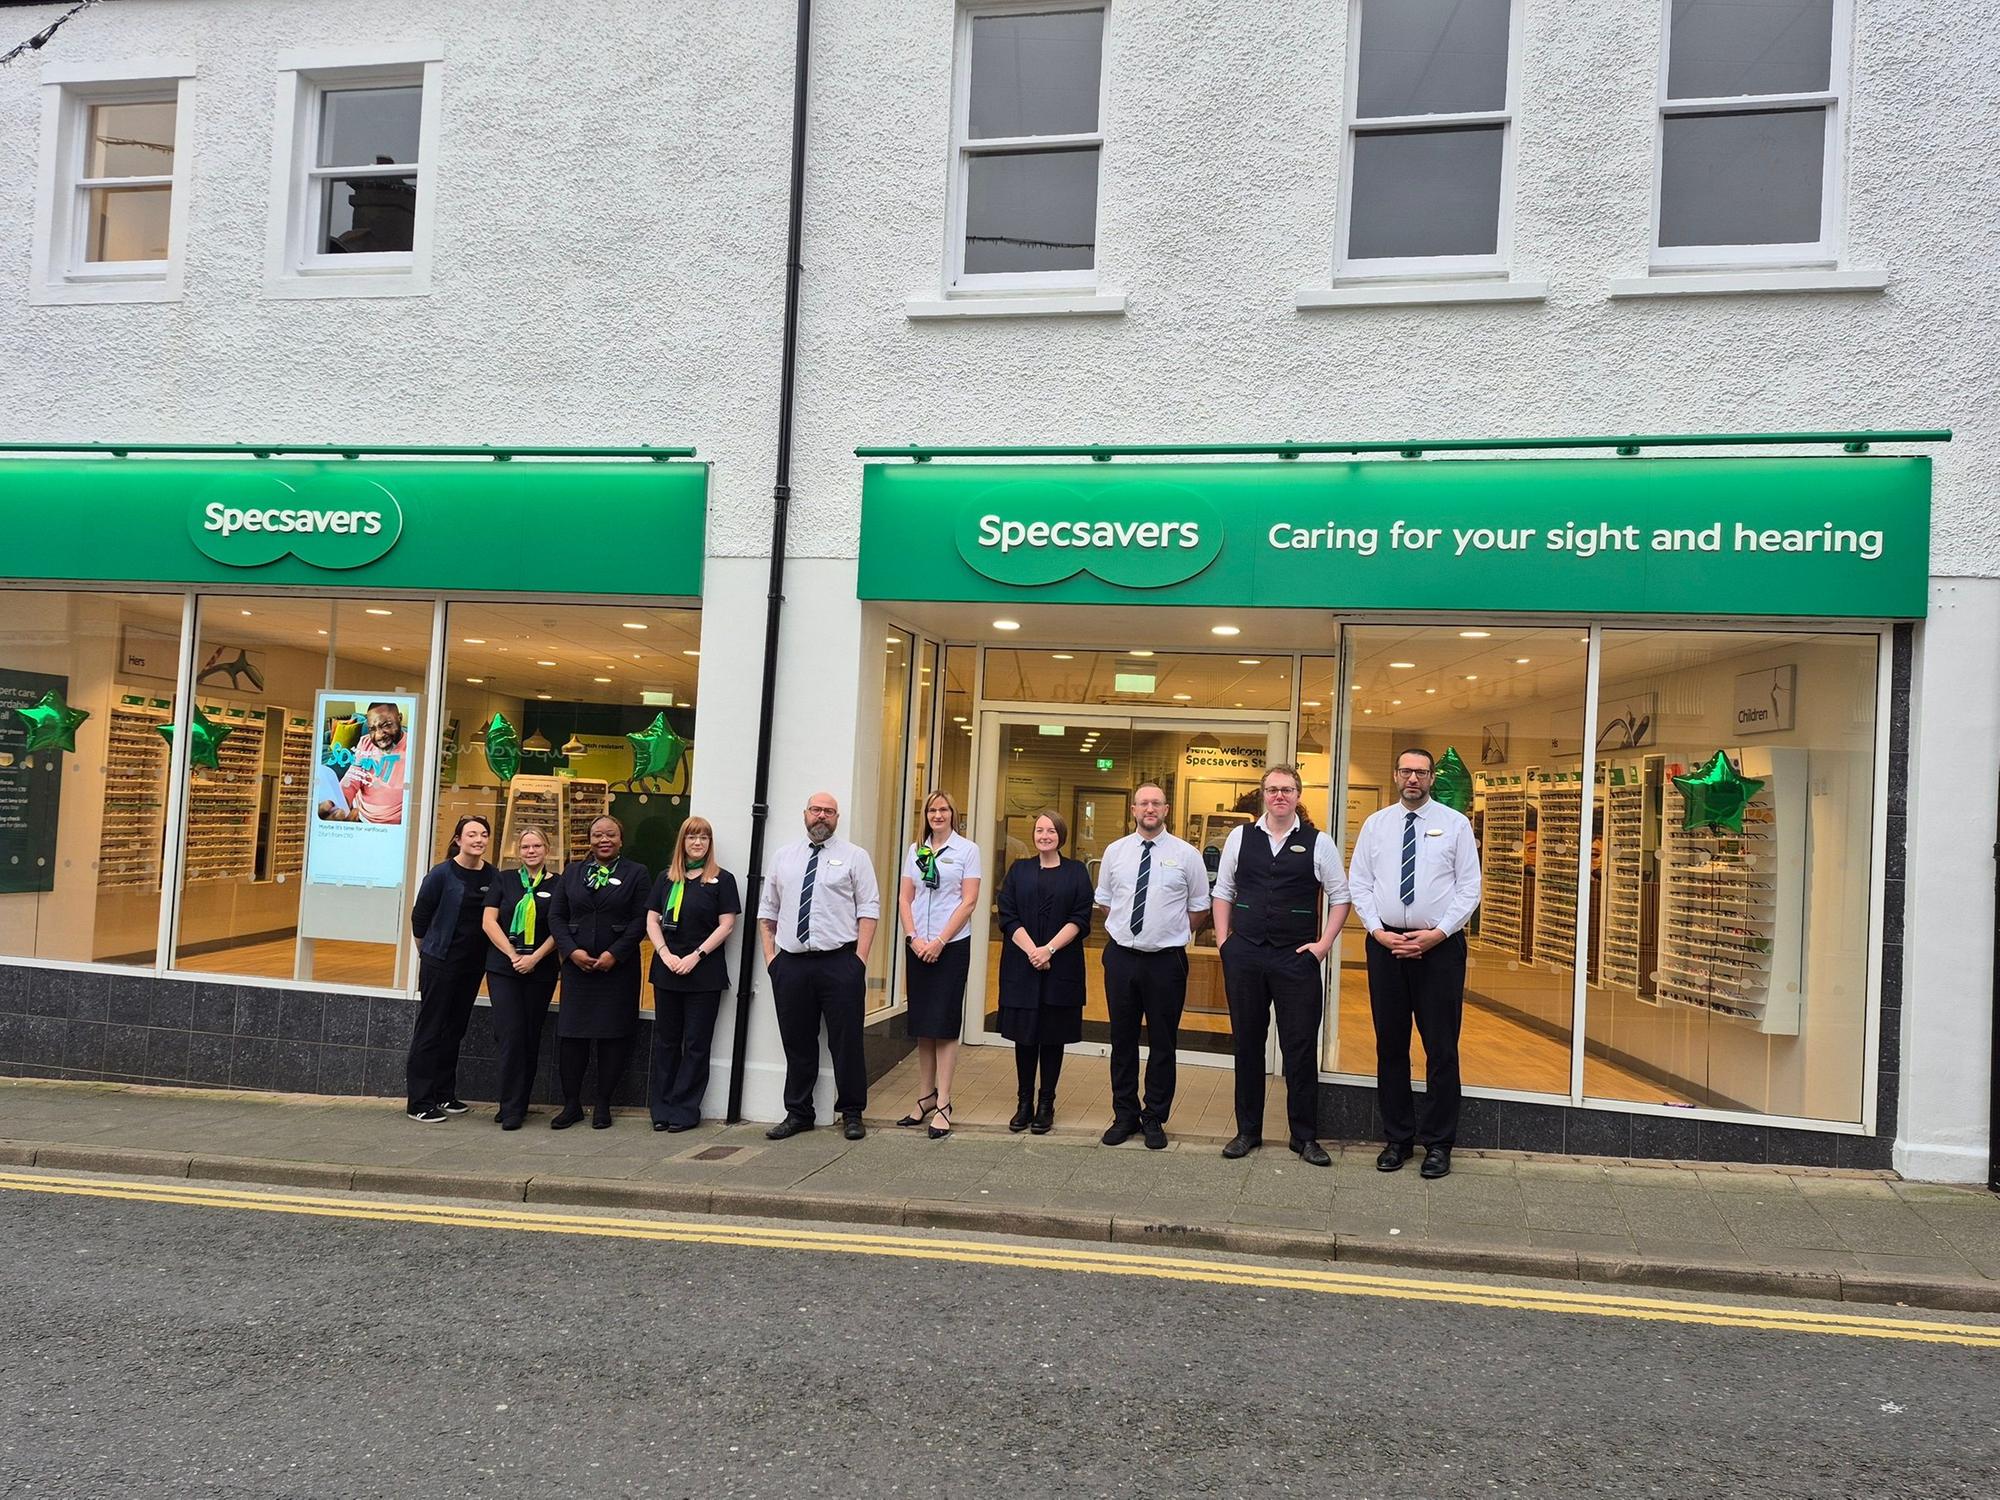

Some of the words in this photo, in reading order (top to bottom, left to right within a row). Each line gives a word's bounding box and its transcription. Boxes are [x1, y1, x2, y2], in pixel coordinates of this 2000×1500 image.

[204, 502, 382, 536] Specsavers
[978, 514, 1199, 552] Specsavers
[1268, 522, 1377, 556] Caring
[1389, 520, 1442, 549] for
[1453, 528, 1536, 556] your
[1546, 521, 1640, 557] sight
[1651, 522, 1721, 550] and
[1734, 521, 1883, 559] hearing
[128, 654, 145, 667] Hers
[1737, 708, 1768, 724] Children
[1186, 754, 1249, 768] Specsavers
